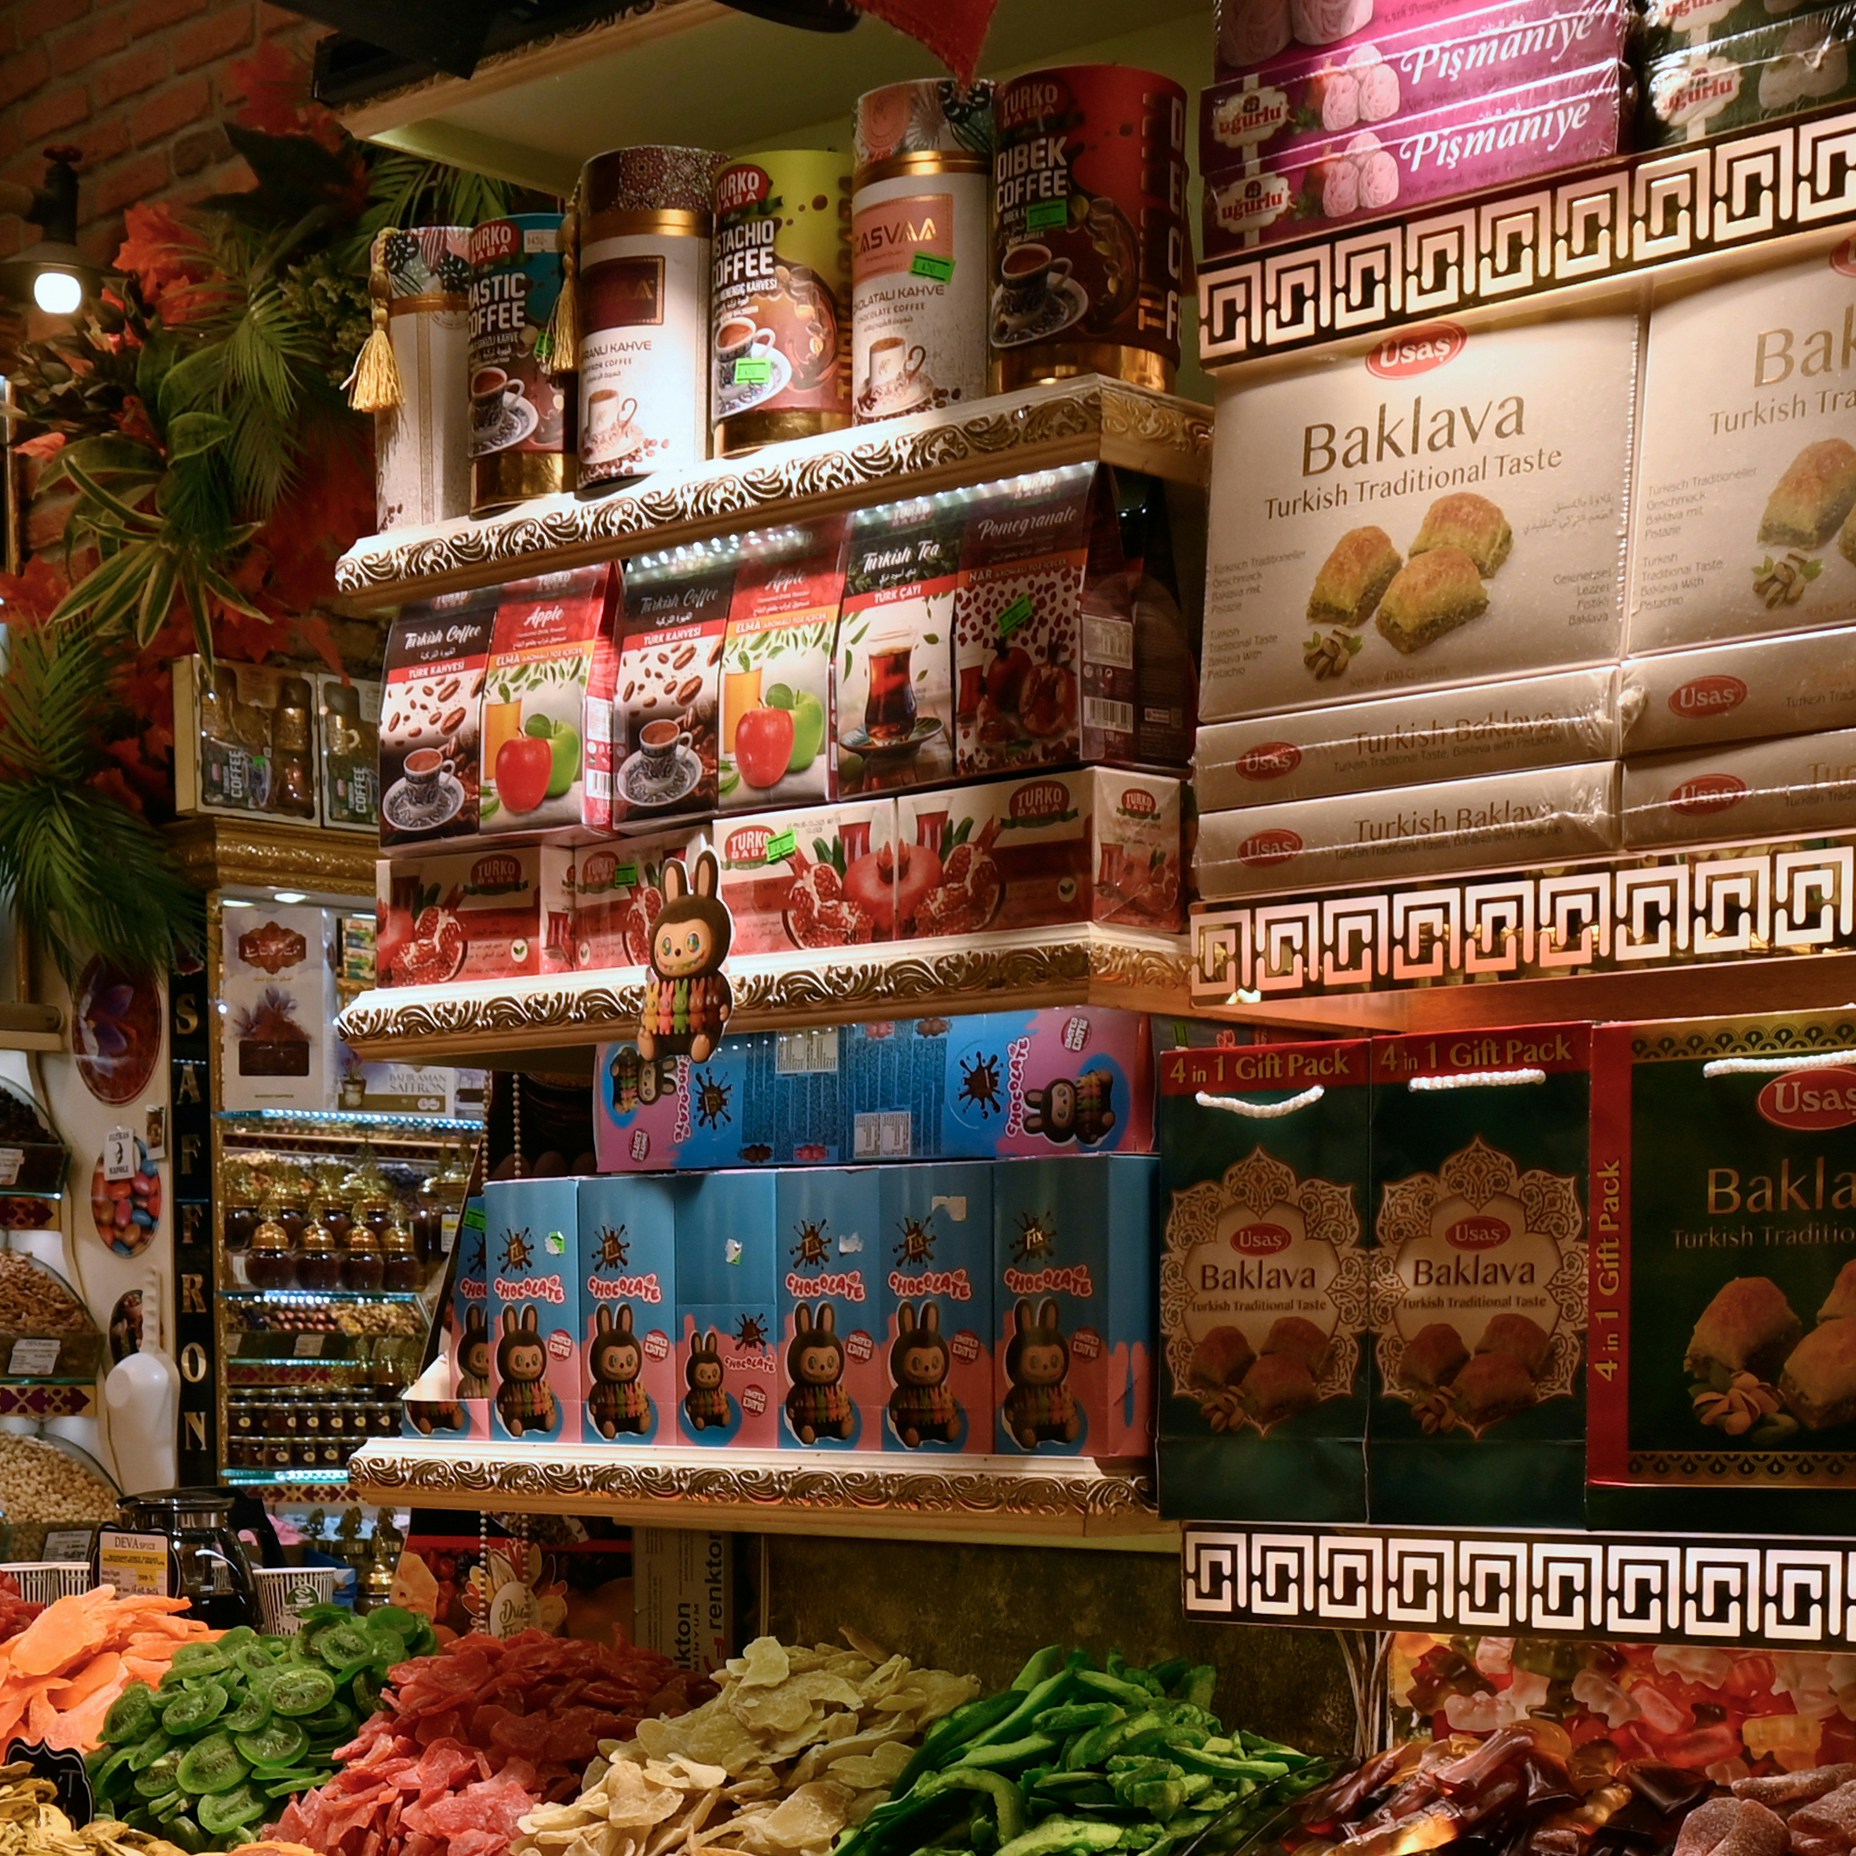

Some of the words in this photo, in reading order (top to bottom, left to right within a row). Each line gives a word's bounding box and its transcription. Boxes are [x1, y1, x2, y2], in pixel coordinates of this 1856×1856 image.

[1399, 16, 1593, 85] Pişmaniye
[1399, 101, 1591, 173] Pişmaniye
[996, 136, 1068, 183] DIBEK
[996, 168, 1068, 214] COFFEE
[897, 284, 945, 301] KAHVE
[1378, 328, 1455, 369] Usaş
[1709, 382, 1807, 437] Turkish
[1301, 394, 1526, 478] Baklava
[1265, 485, 1349, 521] Turkish
[1354, 456, 1487, 504] Traditional
[1495, 445, 1564, 480] Taste
[978, 506, 1078, 542] Pomegranate
[863, 546, 912, 573] Turkish
[916, 539, 941, 560] Tea
[765, 567, 806, 591] Apple
[968, 569, 993, 584] NAR
[523, 605, 564, 627] Apple
[640, 594, 680, 615] Turkish
[683, 587, 719, 609] Coffee
[405, 628, 444, 650] Turkish
[446, 623, 483, 643] Coffee
[735, 619, 762, 634] ELMA
[1352, 721, 1446, 757] Turkish
[230, 750, 244, 799] COFFEE
[354, 766, 367, 814] COFFEE
[1016, 786, 1063, 806] TURKO
[1124, 791, 1153, 806] TURKO
[1353, 814, 1447, 844] Turkish
[1456, 800, 1555, 835] Baklava
[476, 861, 516, 879] TURKO
[1170, 1056, 1187, 1084] 4
[1192, 1060, 1209, 1083] in
[1234, 1050, 1283, 1081] Gift
[1287, 1046, 1351, 1079] Pack
[1401, 1049, 1419, 1071] in
[1449, 1038, 1501, 1069] Gift
[1505, 1033, 1574, 1064] Pack
[1006, 1036, 1031, 1137] CHOCOLATE
[1599, 1158, 1623, 1240] Pack
[1671, 1227, 1754, 1249] Turkish
[786, 1271, 866, 1301] CHOCOLATE
[889, 1269, 972, 1300] CHOCOLATE
[1005, 1264, 1093, 1297] CHOCOLATE
[1200, 1259, 1316, 1293] Baklava
[1412, 1253, 1537, 1288] Baklava
[1598, 1246, 1623, 1298] Gift
[494, 1274, 565, 1304] CHOCOLATE
[588, 1273, 662, 1303] CHOCOLATE
[724, 1354, 776, 1374] CHOCOLATE
[113, 1535, 139, 1551] DEVA
